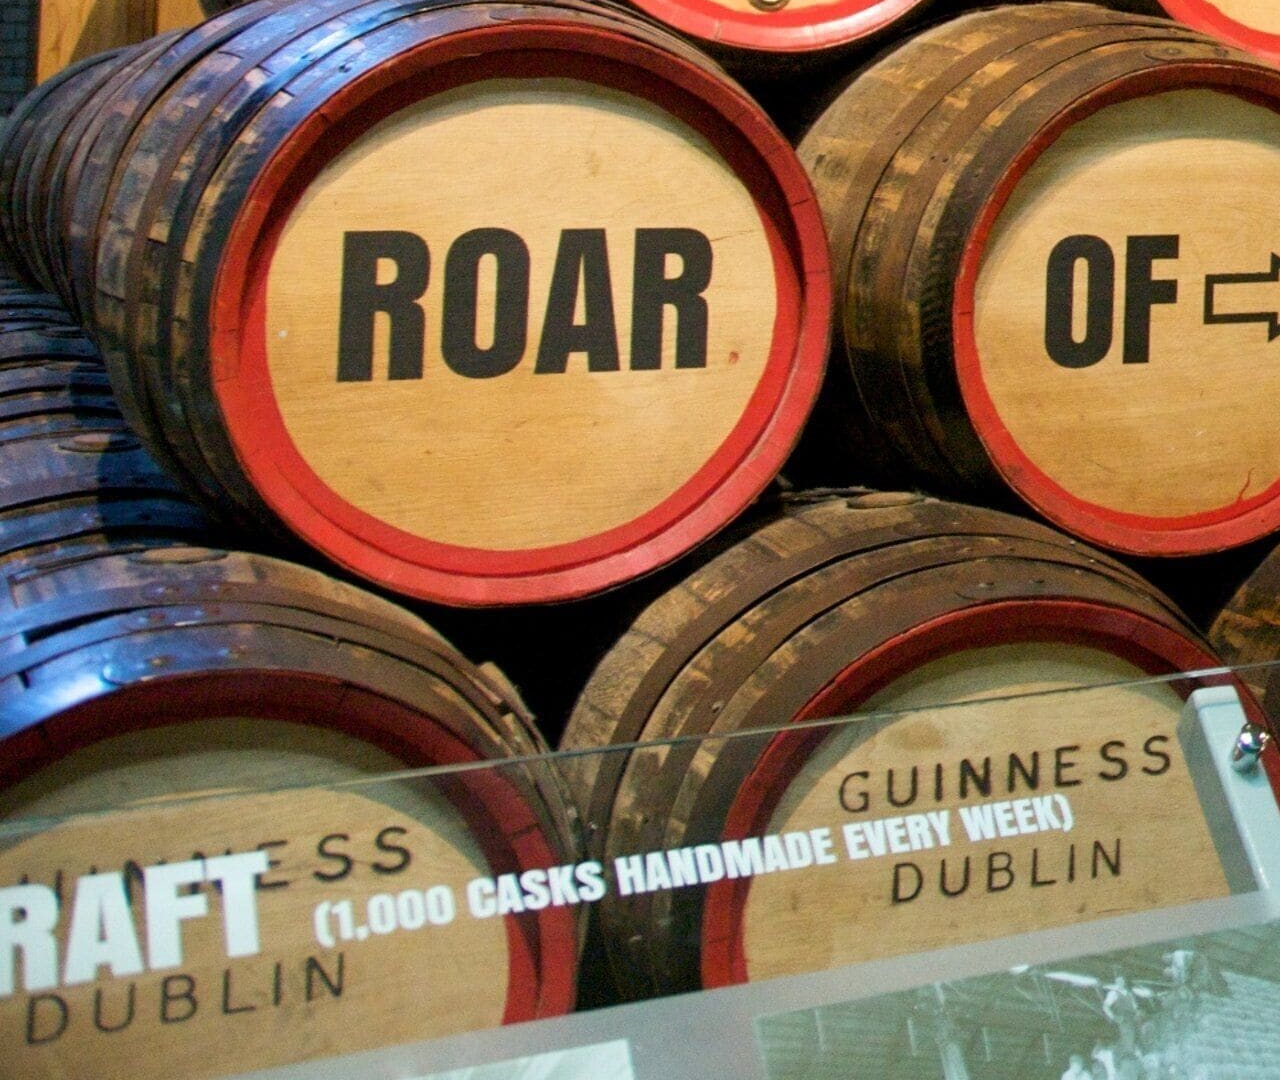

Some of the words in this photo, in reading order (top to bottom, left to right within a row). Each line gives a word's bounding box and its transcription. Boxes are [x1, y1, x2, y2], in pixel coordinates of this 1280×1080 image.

[336, 227, 714, 383] ROAR
[1045, 233, 1180, 369] OF
[839, 735, 1172, 813] GUINNESS
[0, 850, 270, 996] RAFT
[467, 860, 608, 919] CASKS
[614, 827, 836, 897] HANDMADE
[842, 808, 953, 861] EVERY
[958, 793, 1075, 845] WEEK)
[890, 838, 1124, 906] DUBLIN
[27, 953, 346, 1045] DUBLIN
